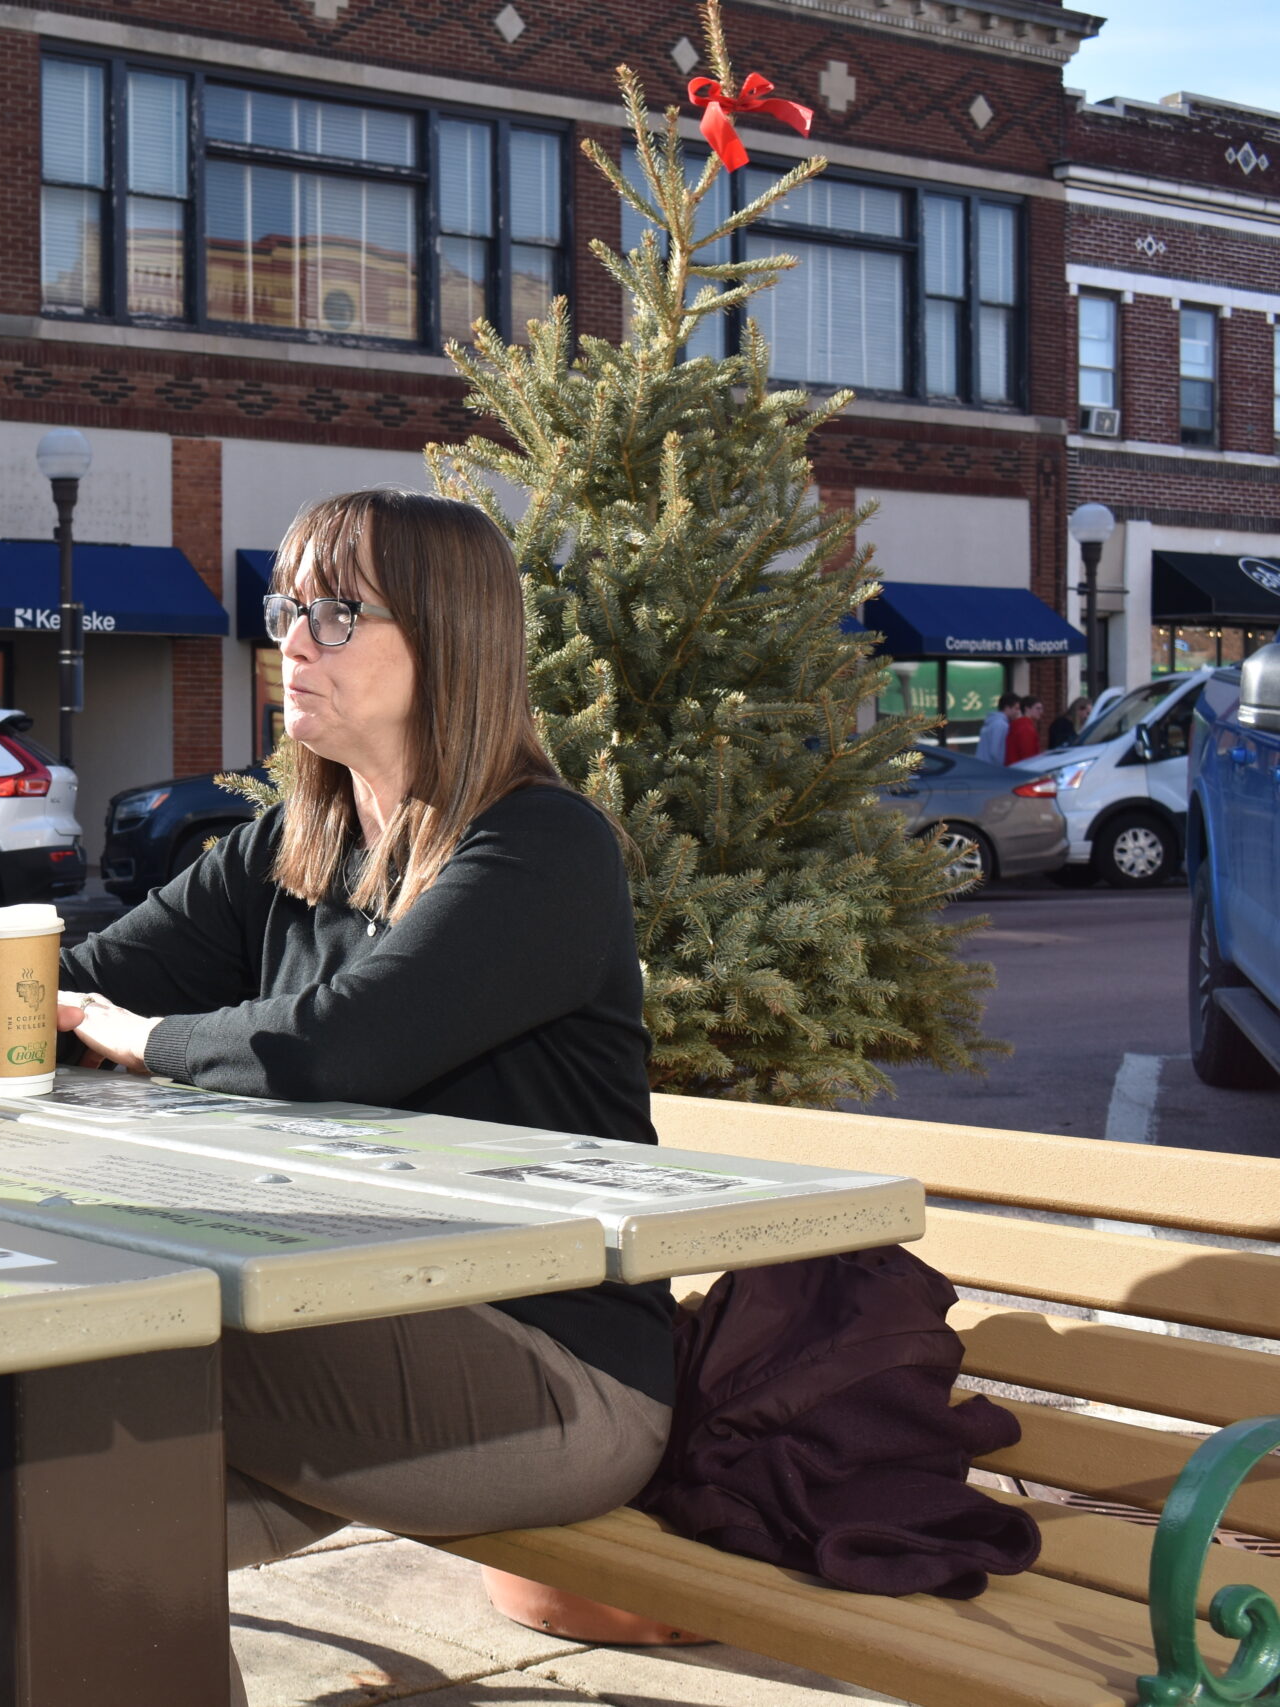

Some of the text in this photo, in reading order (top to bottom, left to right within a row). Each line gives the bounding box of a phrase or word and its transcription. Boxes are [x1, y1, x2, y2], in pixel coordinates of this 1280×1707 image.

[36, 609, 116, 631] Keske
[946, 636, 1069, 654] Computers & IT Support
[16, 1014, 46, 1022] COFFEE
[195, 1222, 309, 1244] Musical
